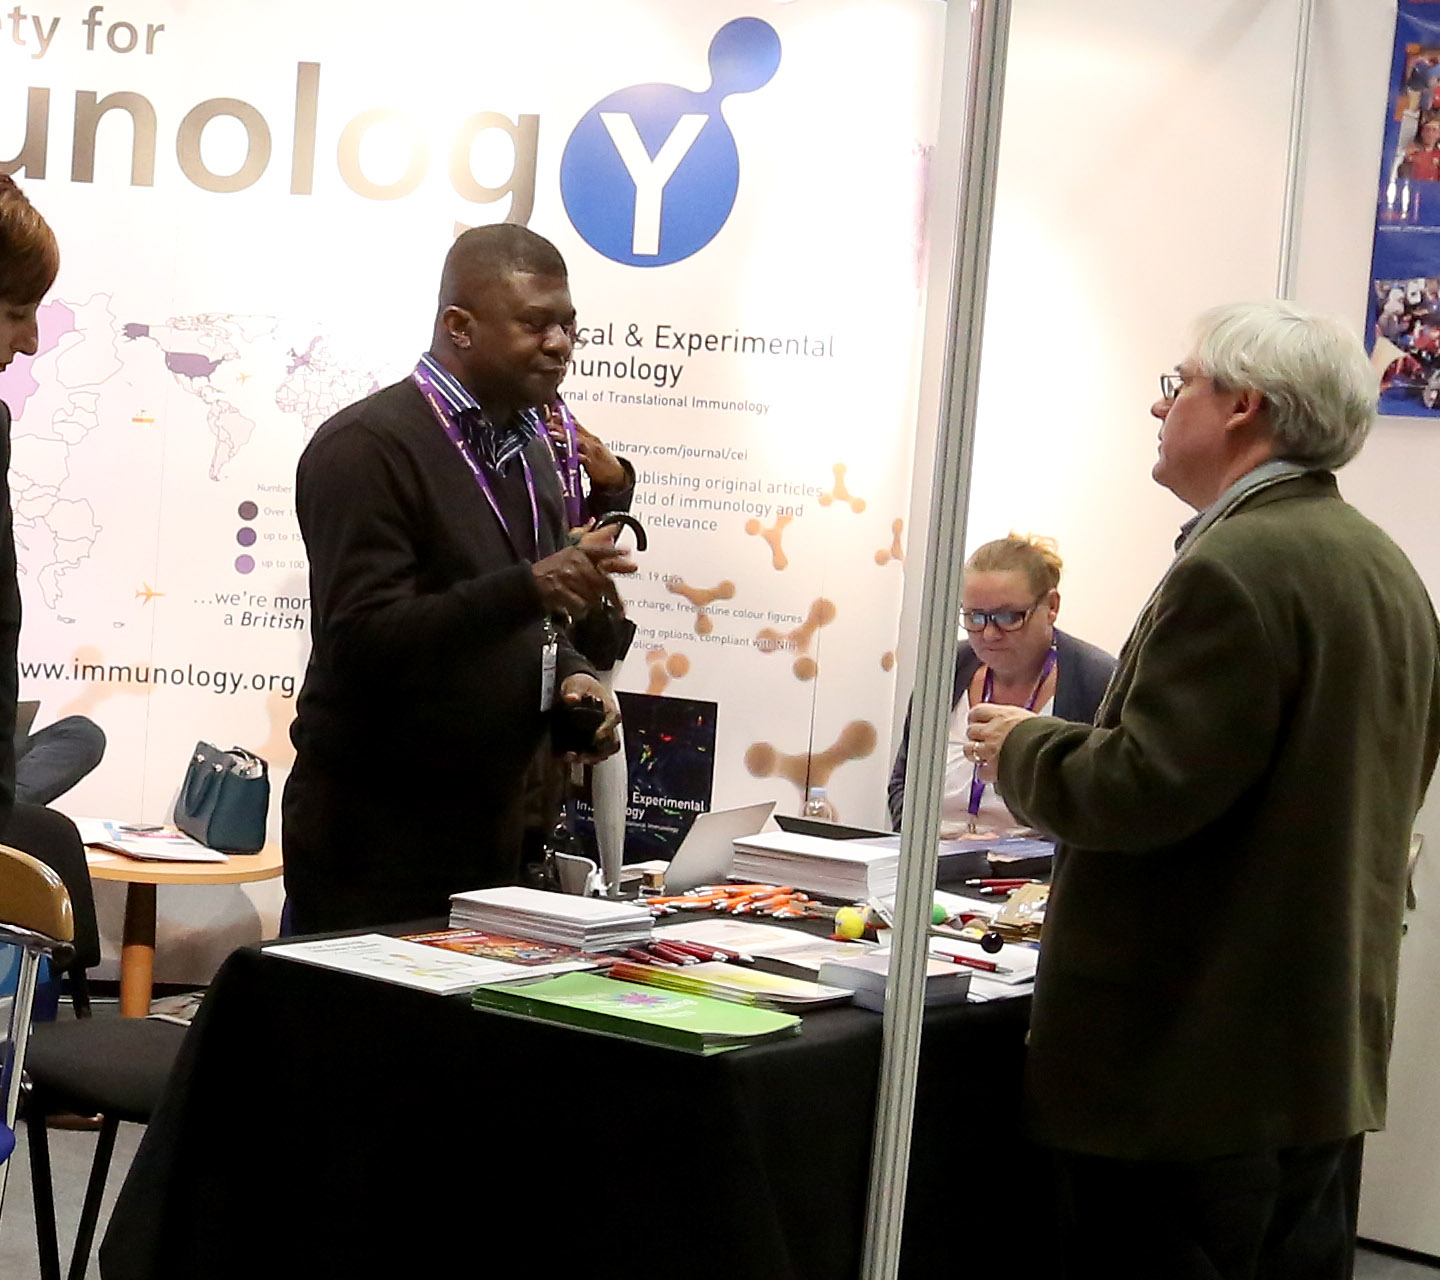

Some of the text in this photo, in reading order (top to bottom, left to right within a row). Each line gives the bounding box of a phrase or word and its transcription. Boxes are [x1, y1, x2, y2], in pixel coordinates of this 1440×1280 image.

[82, 5, 165, 55] for
[625, 324, 643, 347] &
[655, 325, 834, 359] Experimental
[567, 358, 684, 388] unology
[592, 390, 770, 415] of Translational Immunology
[257, 483, 293, 493] Number
[636, 473, 823, 498] ublishing original articles
[661, 494, 803, 518] of immunology and
[648, 515, 718, 531] relevance
[274, 596, 311, 610] mor
[677, 602, 698, 614] free
[700, 604, 729, 616] online
[733, 608, 764, 620] colour
[768, 610, 802, 624] figures
[224, 611, 305, 631] a British
[700, 632, 750, 648] compliant
[632, 792, 704, 812] Experimental
